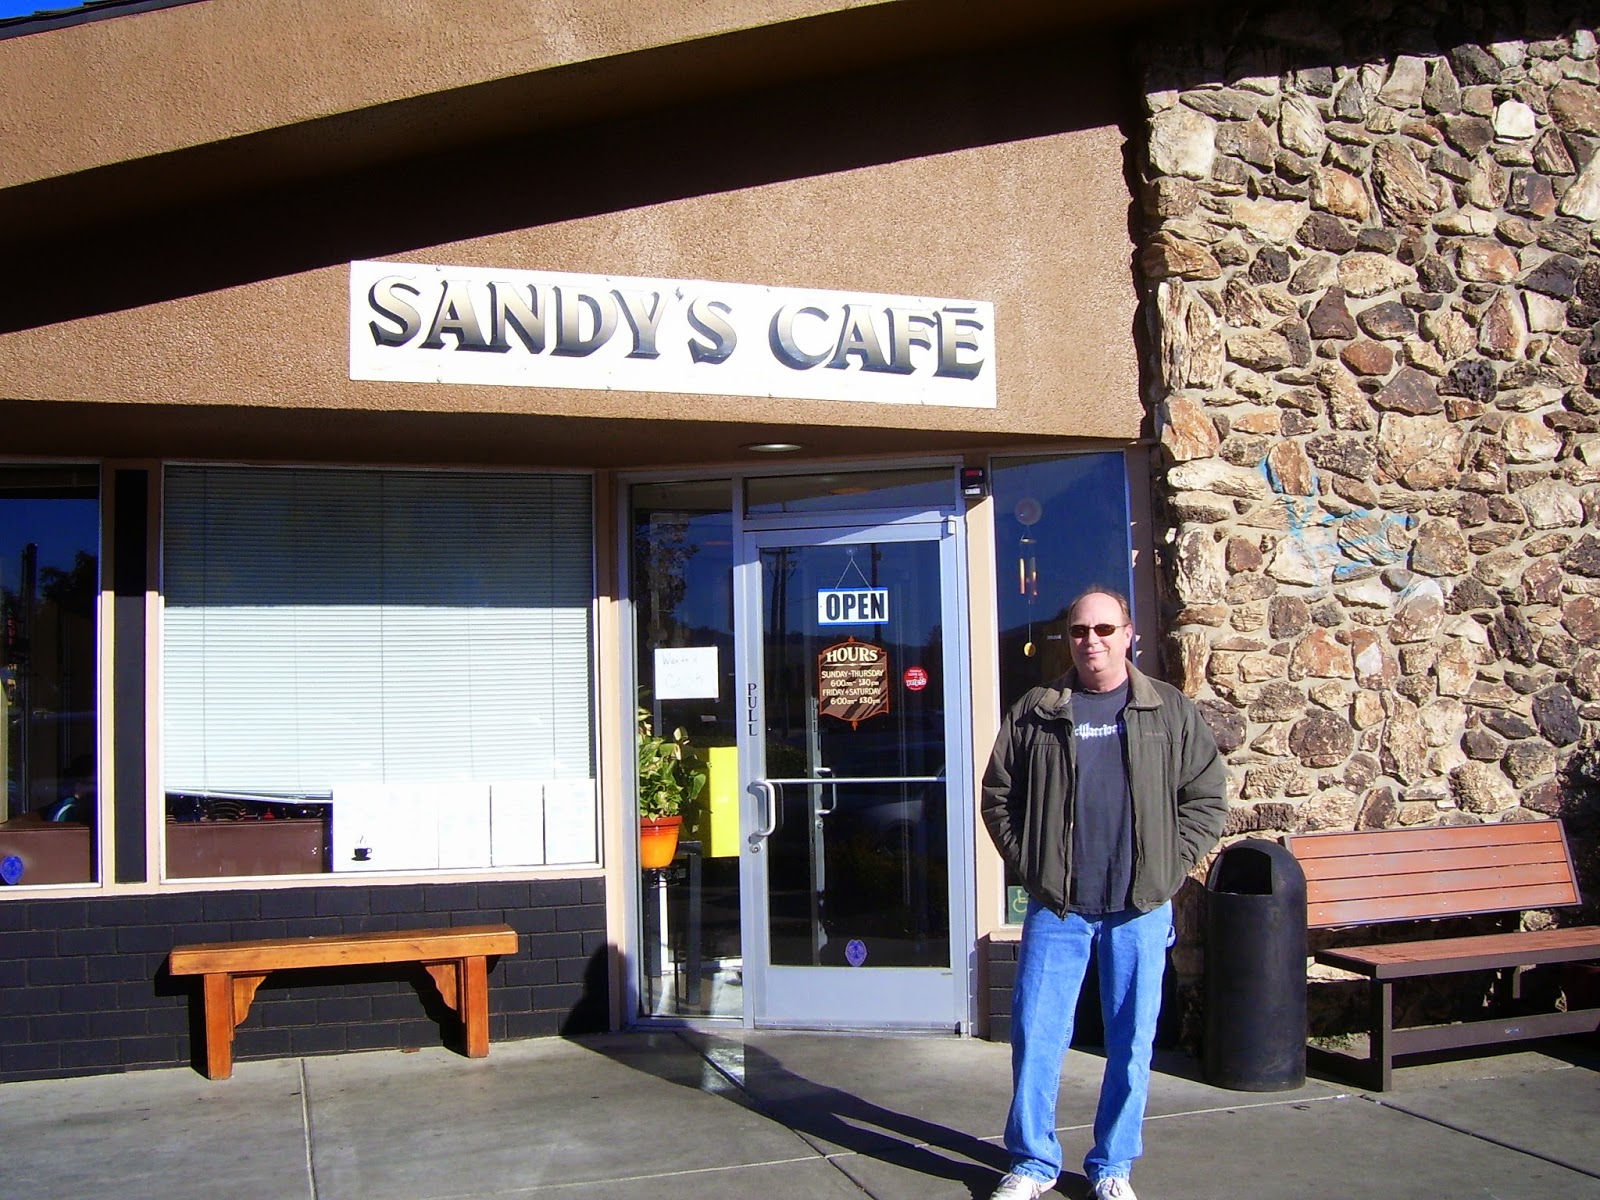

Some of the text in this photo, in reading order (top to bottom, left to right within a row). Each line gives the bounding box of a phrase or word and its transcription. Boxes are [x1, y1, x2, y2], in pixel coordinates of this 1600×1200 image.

[367, 275, 738, 364] SANDY'S
[826, 593, 885, 621] OPEN
[826, 646, 878, 662] HOURS
[747, 683, 758, 737] PULL
